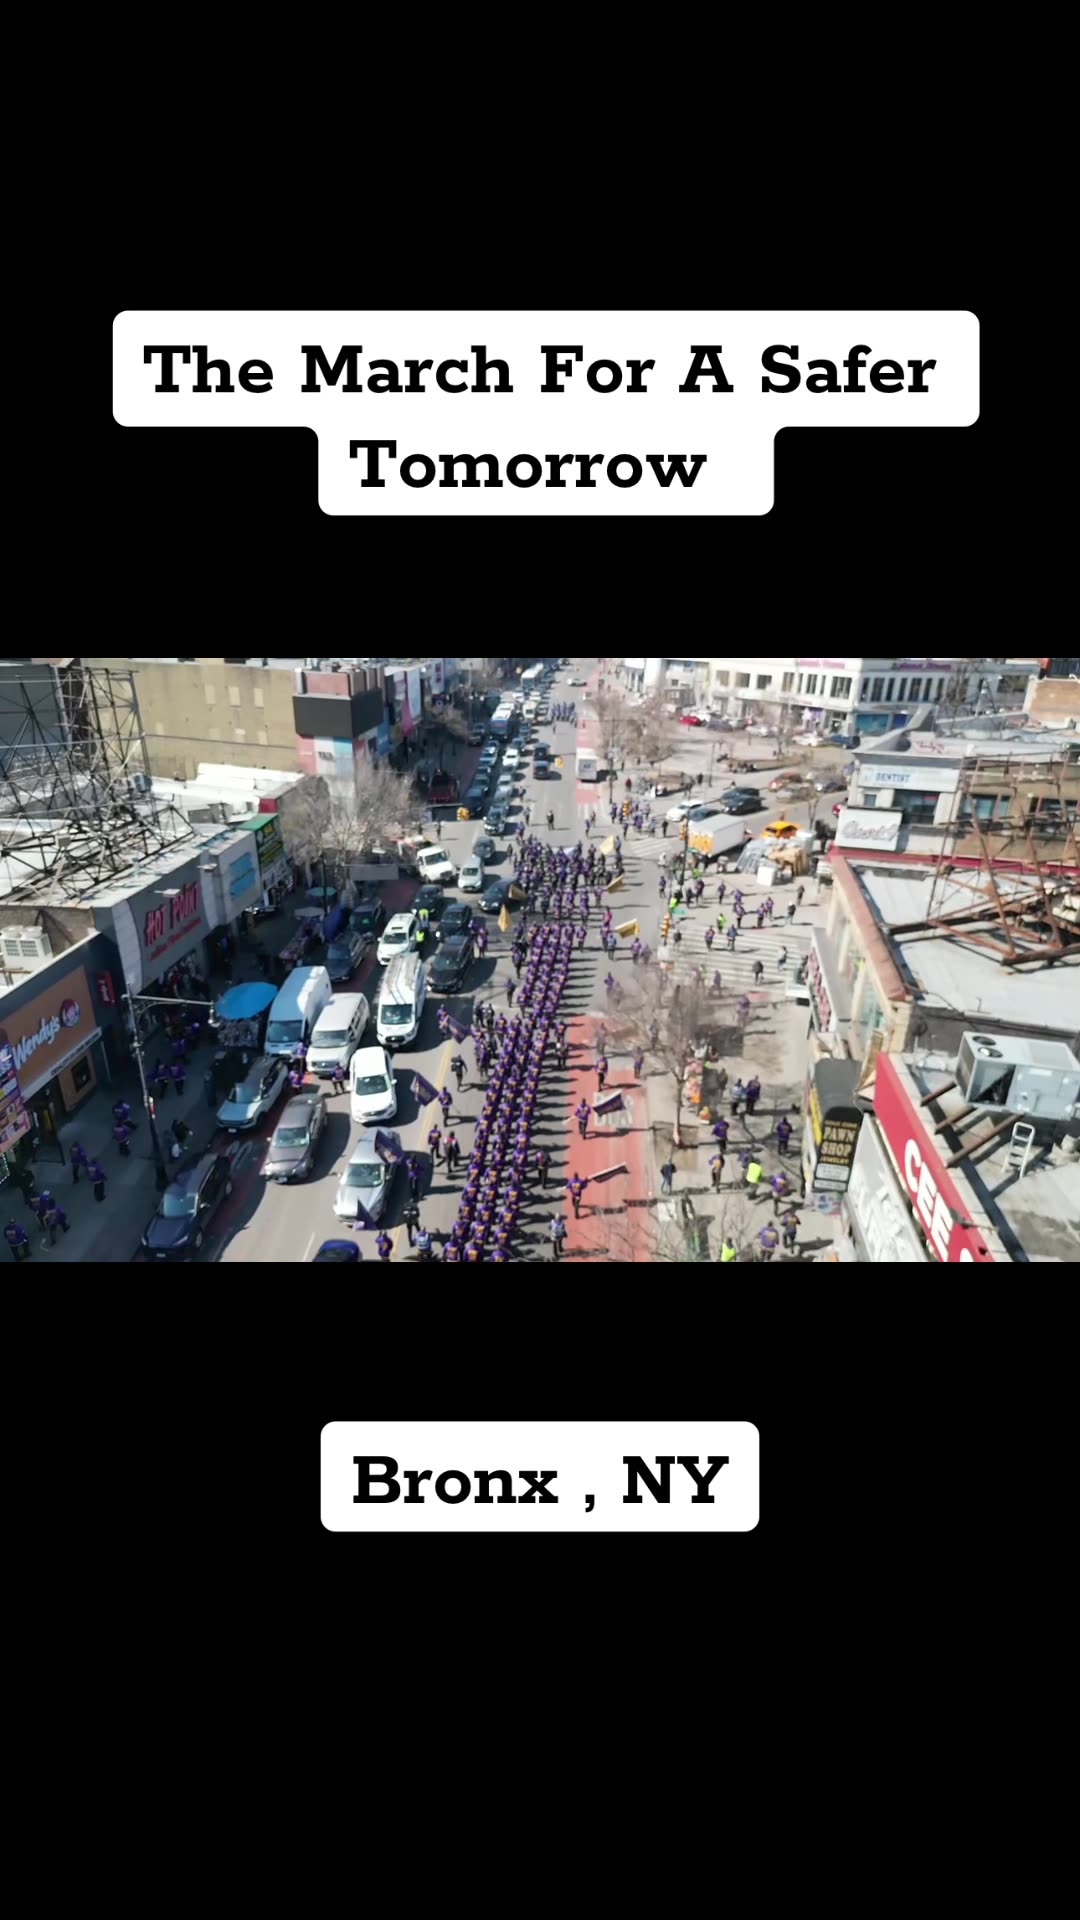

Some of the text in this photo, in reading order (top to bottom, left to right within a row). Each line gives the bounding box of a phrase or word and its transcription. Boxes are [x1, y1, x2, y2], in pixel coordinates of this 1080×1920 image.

[875, 772, 911, 783] DENTIST
[145, 904, 168, 947] HOT
[12, 1015, 60, 1070] Wendy's
[824, 1127, 856, 1143] PAWN
[821, 1141, 852, 1157] SHOP
